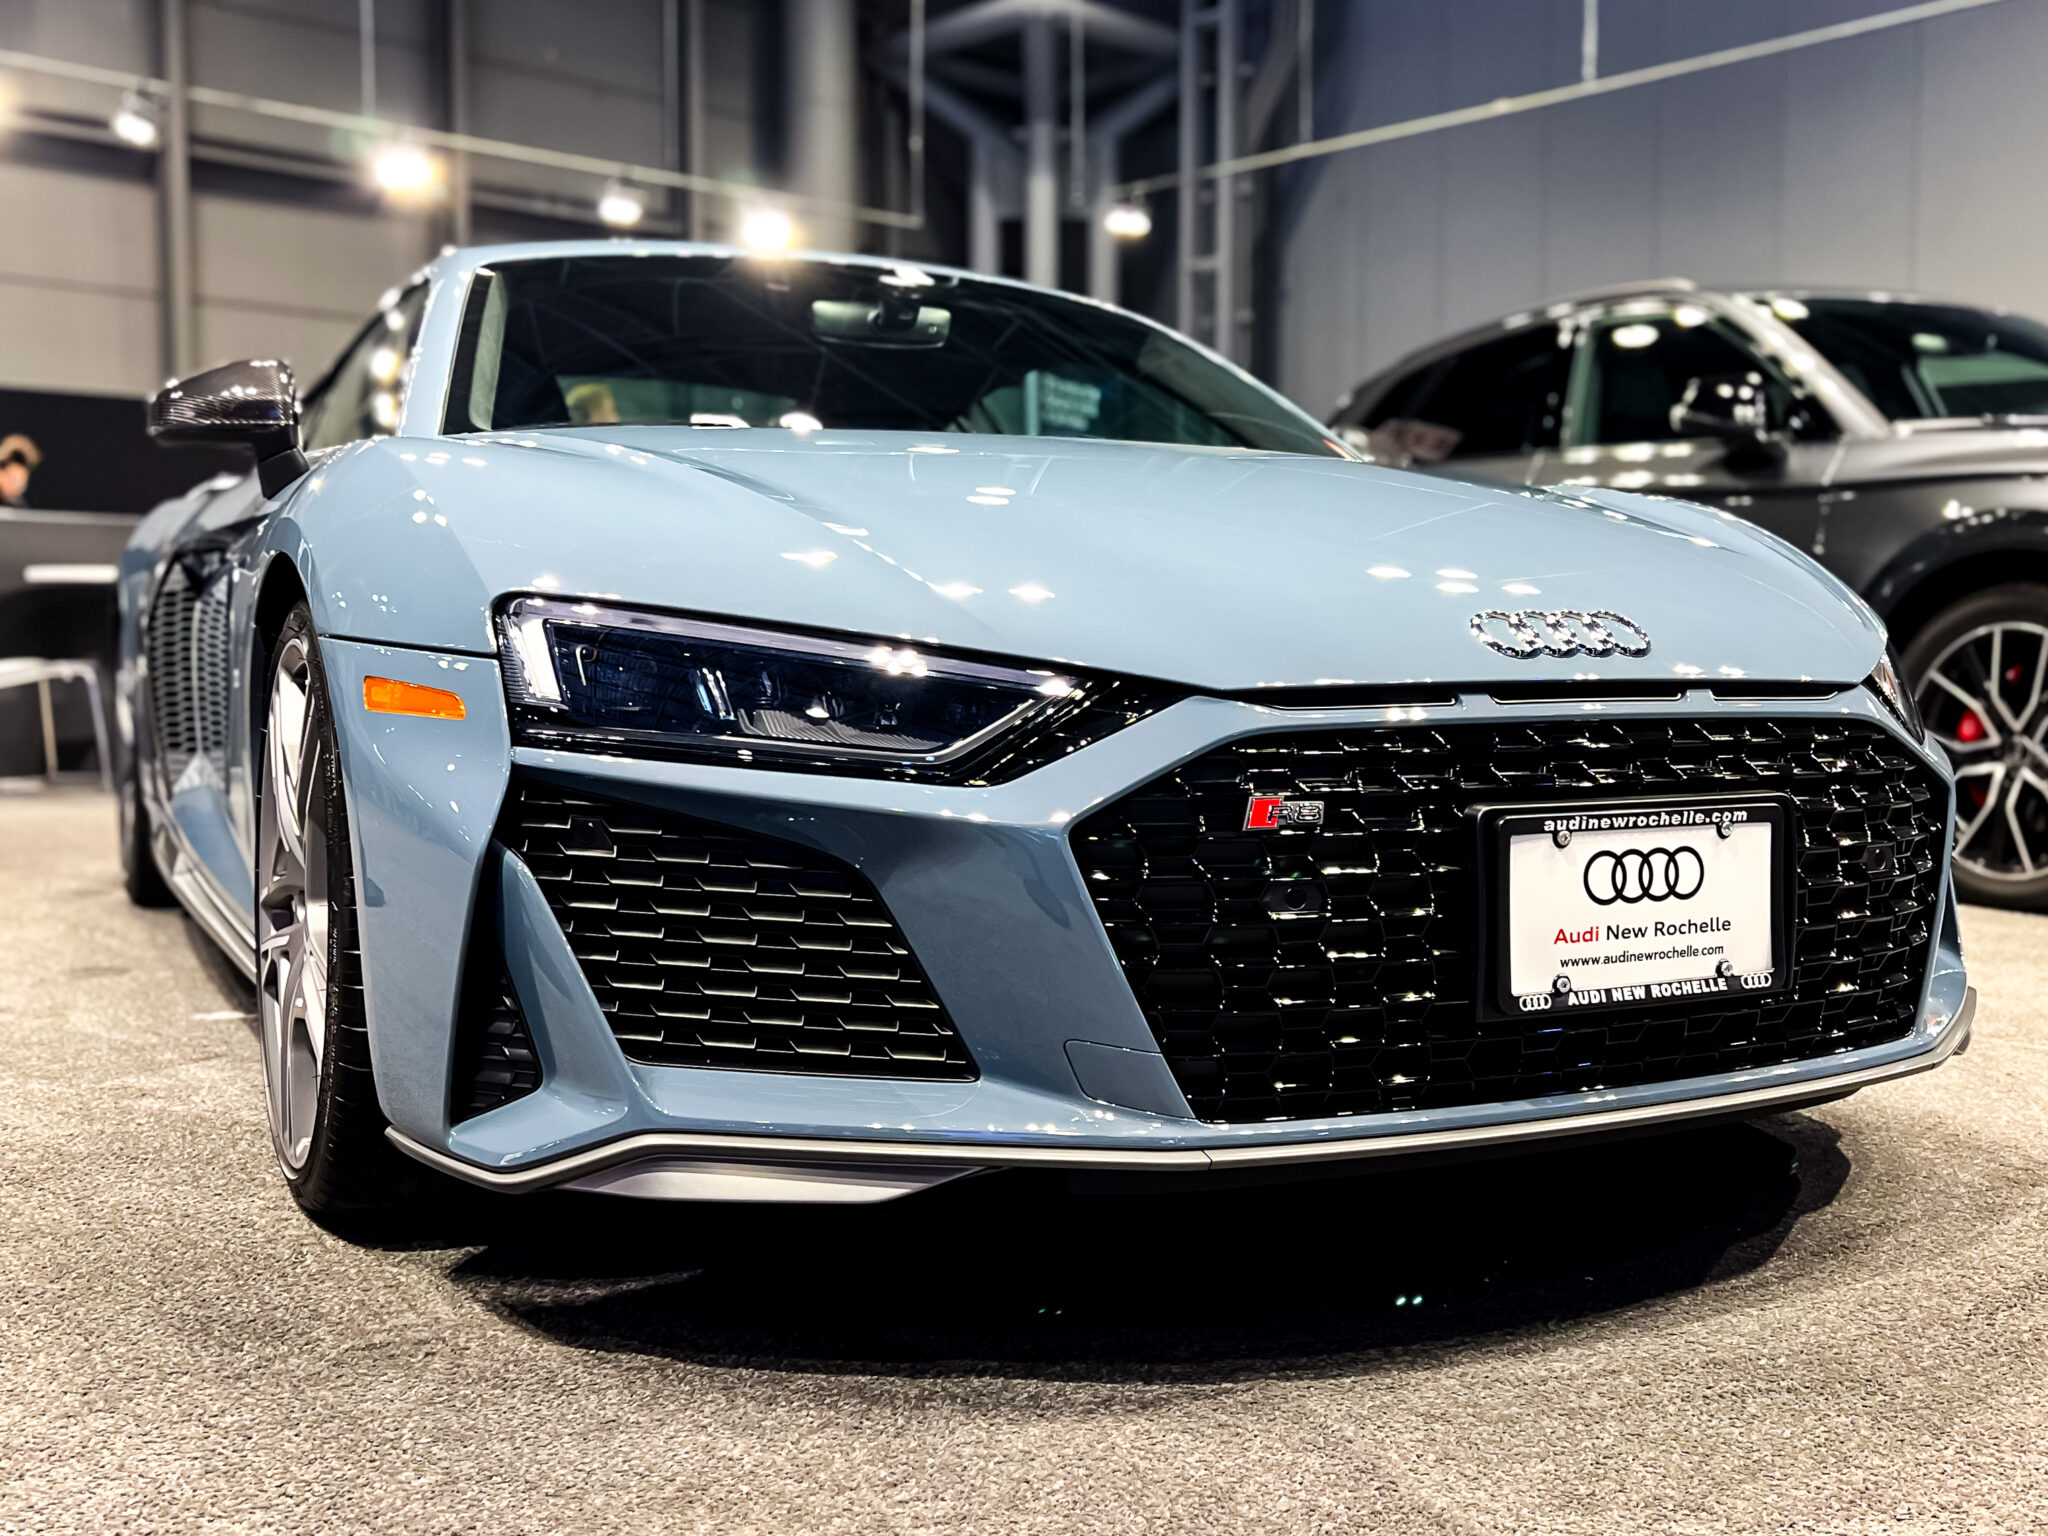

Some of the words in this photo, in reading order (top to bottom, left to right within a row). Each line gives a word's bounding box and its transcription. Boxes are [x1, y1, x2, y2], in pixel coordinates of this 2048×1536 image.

[1266, 801, 1323, 824] R8
[1543, 810, 1748, 832] audinewrochelle.com
[1553, 925, 1600, 945] Audi
[1606, 924, 1649, 941] New
[1654, 916, 1732, 937] Rochelle
[1567, 989, 1608, 1006] AUDI
[1611, 985, 1646, 1002] NEW
[1649, 977, 1728, 998] ROCHELLE
